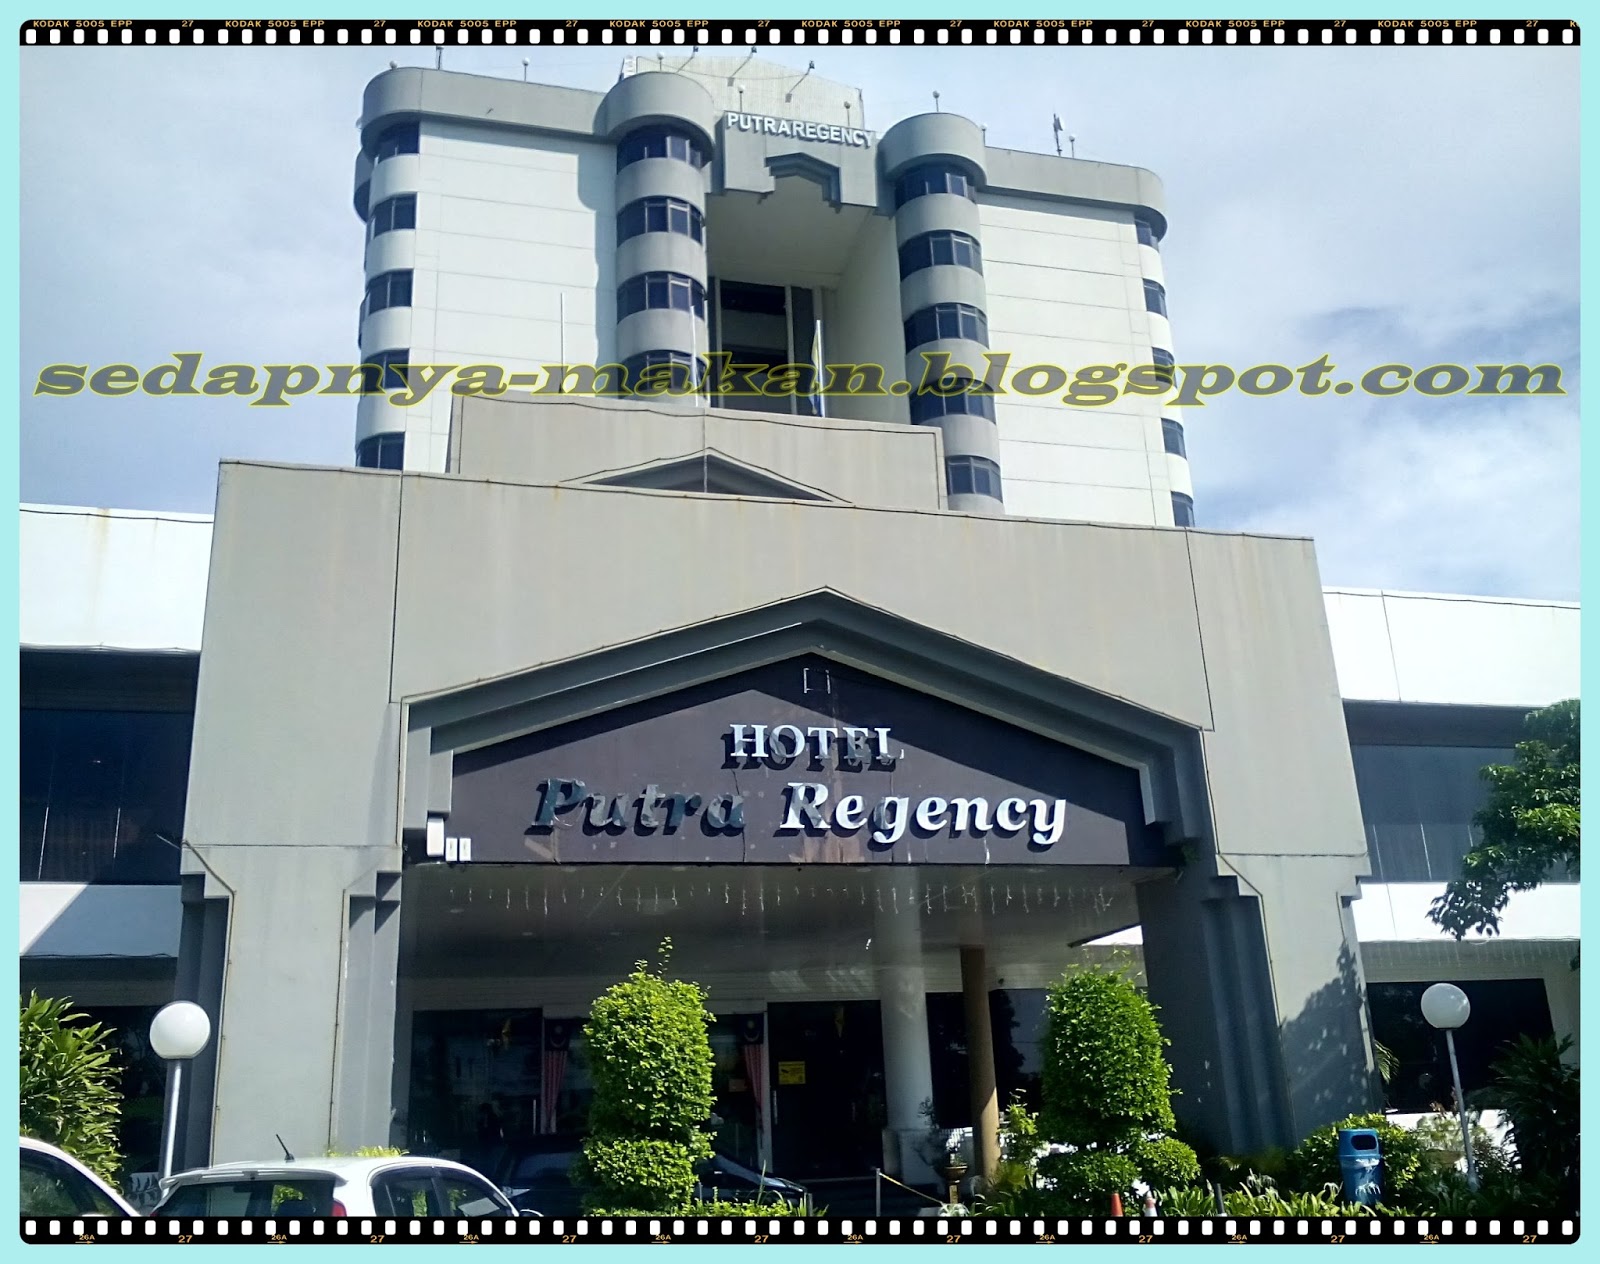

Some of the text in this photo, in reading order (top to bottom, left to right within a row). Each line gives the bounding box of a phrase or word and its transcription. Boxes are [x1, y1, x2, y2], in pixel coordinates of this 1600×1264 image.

[727, 723, 904, 765] HOTEL
[530, 777, 1067, 844] Putra Regency
